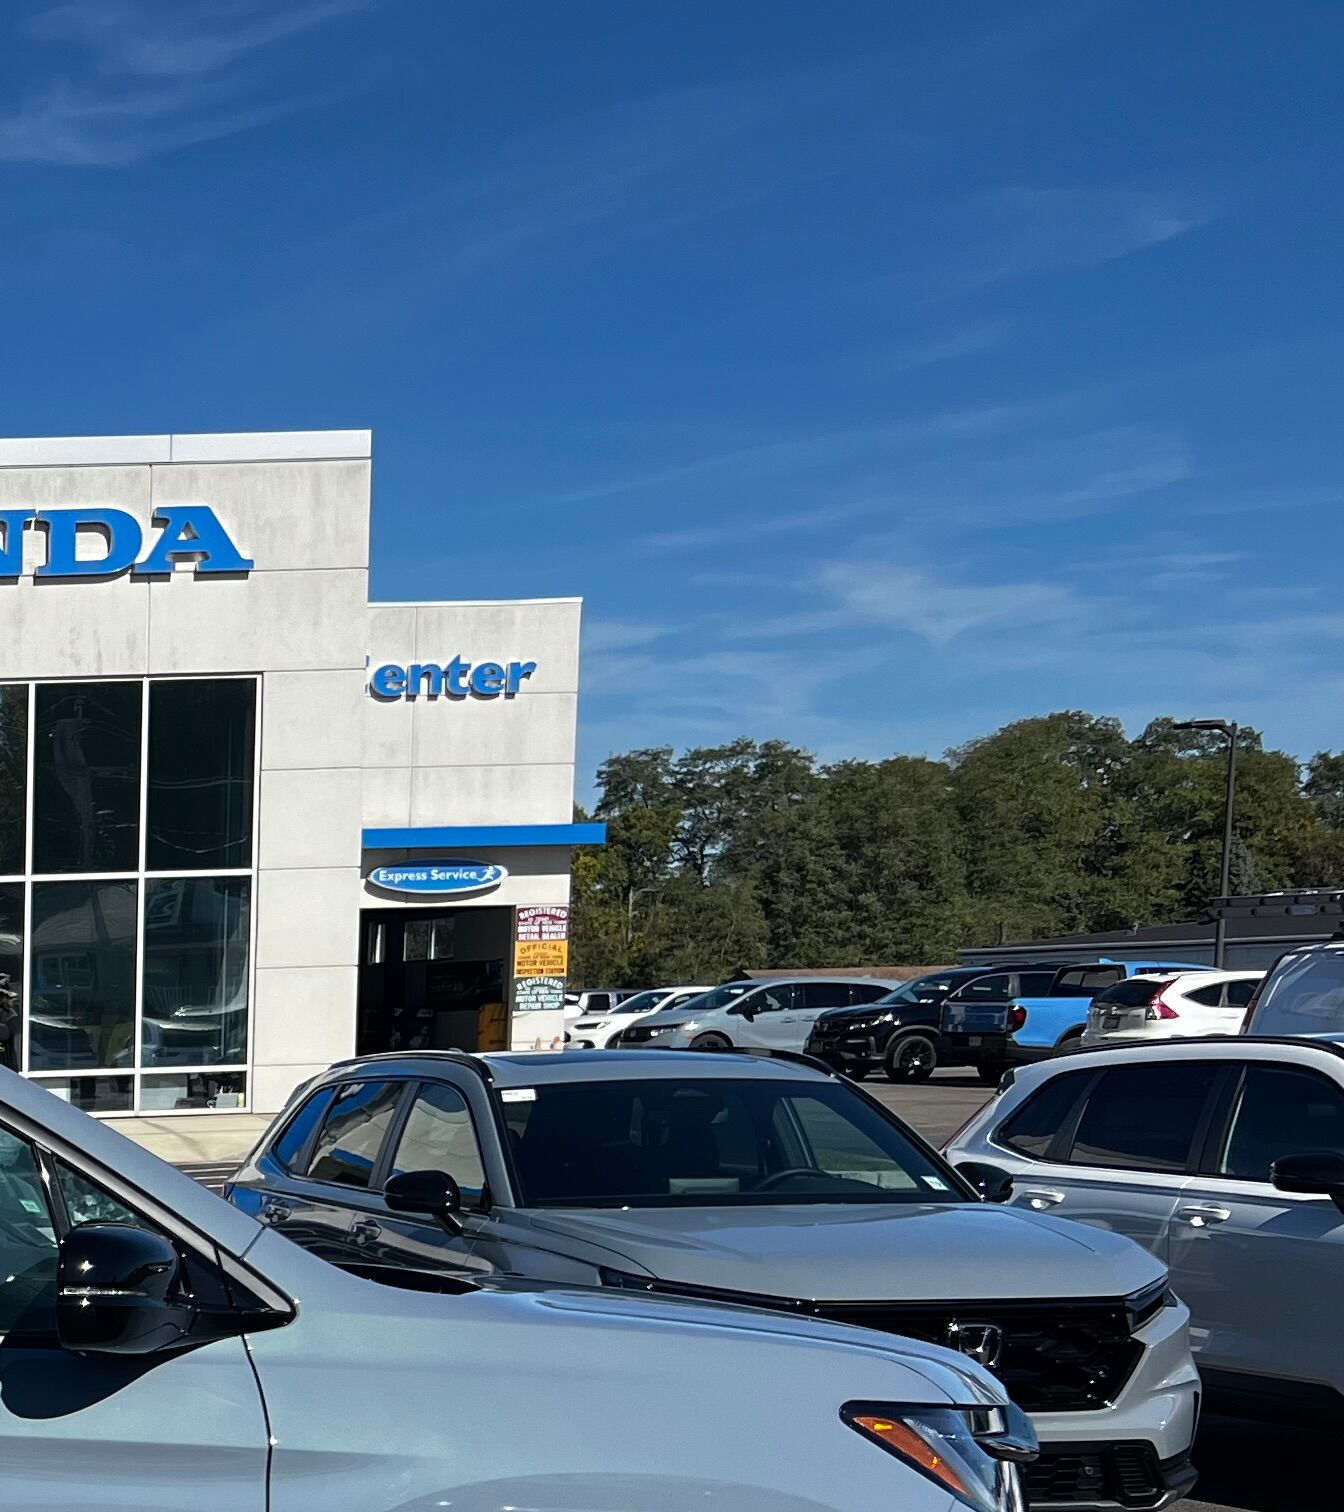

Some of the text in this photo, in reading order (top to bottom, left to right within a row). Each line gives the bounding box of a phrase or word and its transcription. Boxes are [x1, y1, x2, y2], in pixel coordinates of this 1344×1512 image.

[365, 653, 538, 699] enter
[378, 867, 477, 883] Express Service
[520, 943, 562, 954] OFFICIAL
